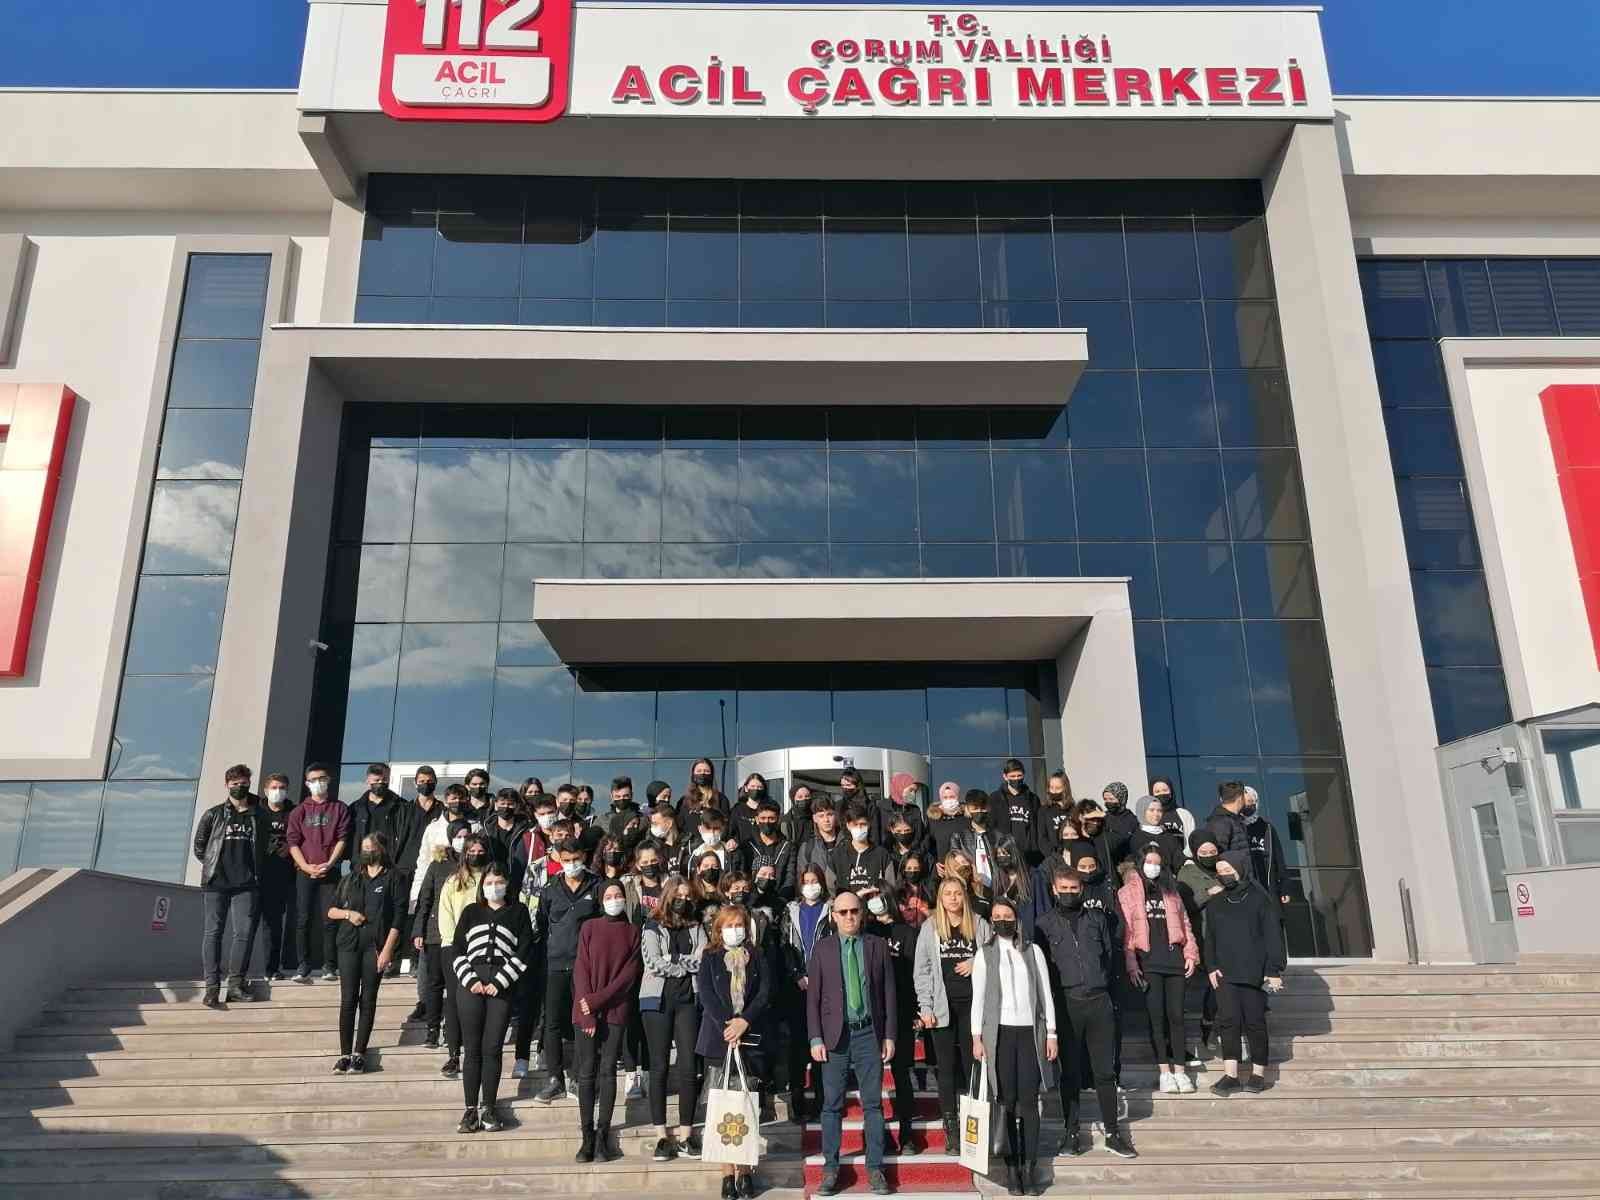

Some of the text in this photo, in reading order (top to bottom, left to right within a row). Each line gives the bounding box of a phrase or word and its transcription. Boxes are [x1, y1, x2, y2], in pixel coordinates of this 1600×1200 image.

[416, 0, 541, 49] 112
[928, 14, 991, 36] T.C.
[811, 34, 1112, 69] ÇORUM VALİLİĞİ
[611, 56, 767, 105] ACİL
[1016, 58, 1308, 106] MERKEZİ
